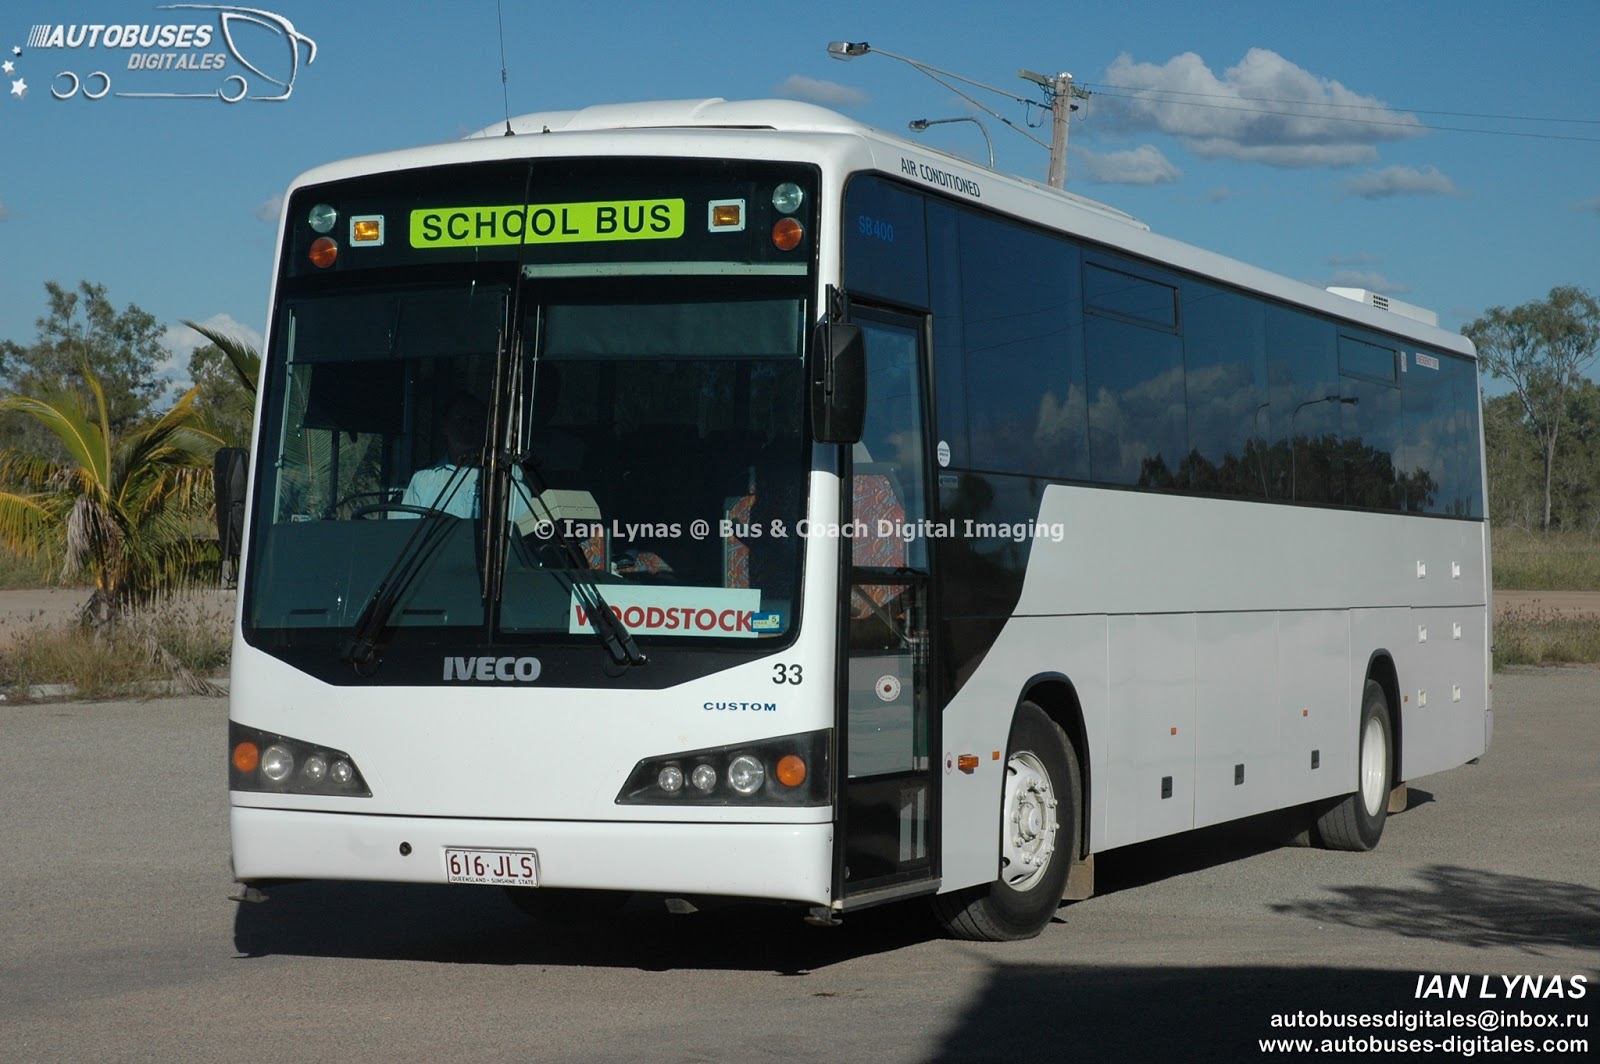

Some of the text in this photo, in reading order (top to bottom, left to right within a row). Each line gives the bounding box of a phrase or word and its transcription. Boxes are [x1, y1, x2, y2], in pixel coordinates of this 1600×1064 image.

[900, 157, 981, 198] AIR CONDITIONED
[422, 204, 671, 241] SCHOOL BUS
[859, 215, 894, 242] SB400
[443, 657, 542, 681] IVECO
[772, 663, 803, 685] 33
[703, 702, 777, 711] CUSTOM
